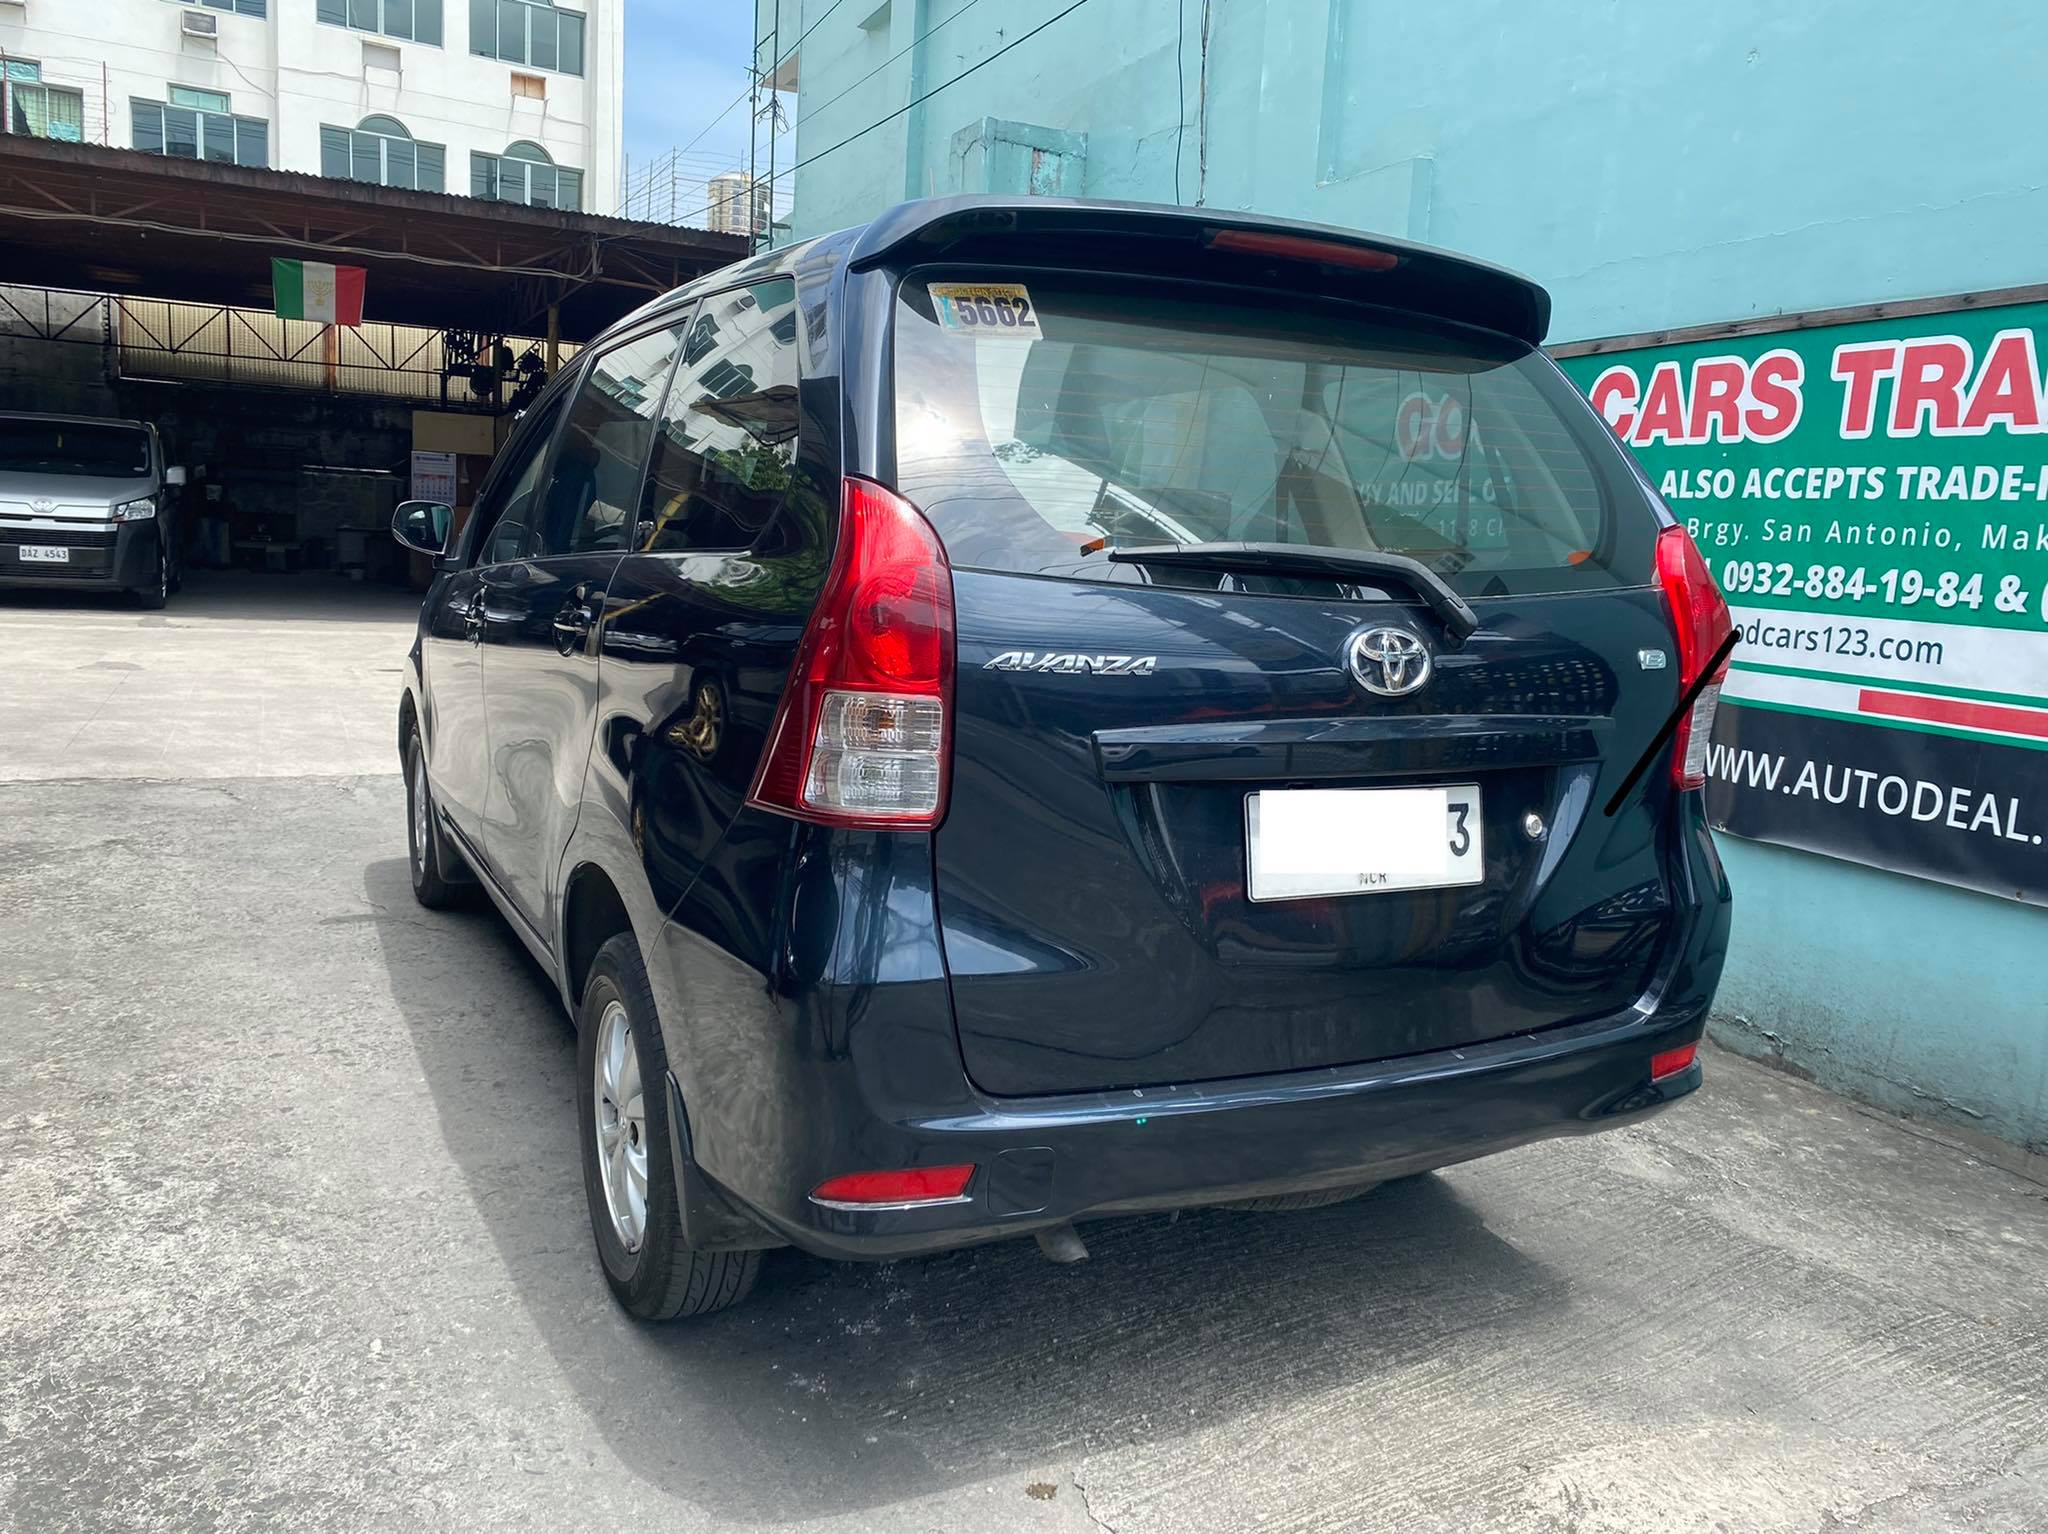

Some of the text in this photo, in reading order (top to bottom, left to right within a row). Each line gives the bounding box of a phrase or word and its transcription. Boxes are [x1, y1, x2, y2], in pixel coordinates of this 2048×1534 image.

[954, 296, 1036, 327] 5662
[1588, 328, 2048, 447] CARS TRA
[1395, 391, 1464, 461] GO
[1385, 480, 1428, 505] AND
[1660, 468, 1736, 499] ALSO
[1741, 466, 1887, 499] ACCEPTS
[1439, 518, 1478, 537] 118
[1687, 517, 2048, 551] Brgy. San Antonio, Mak
[1722, 560, 1983, 610] 0932-884-19-84
[1994, 574, 2029, 613] &
[982, 651, 1157, 676] AVANZA
